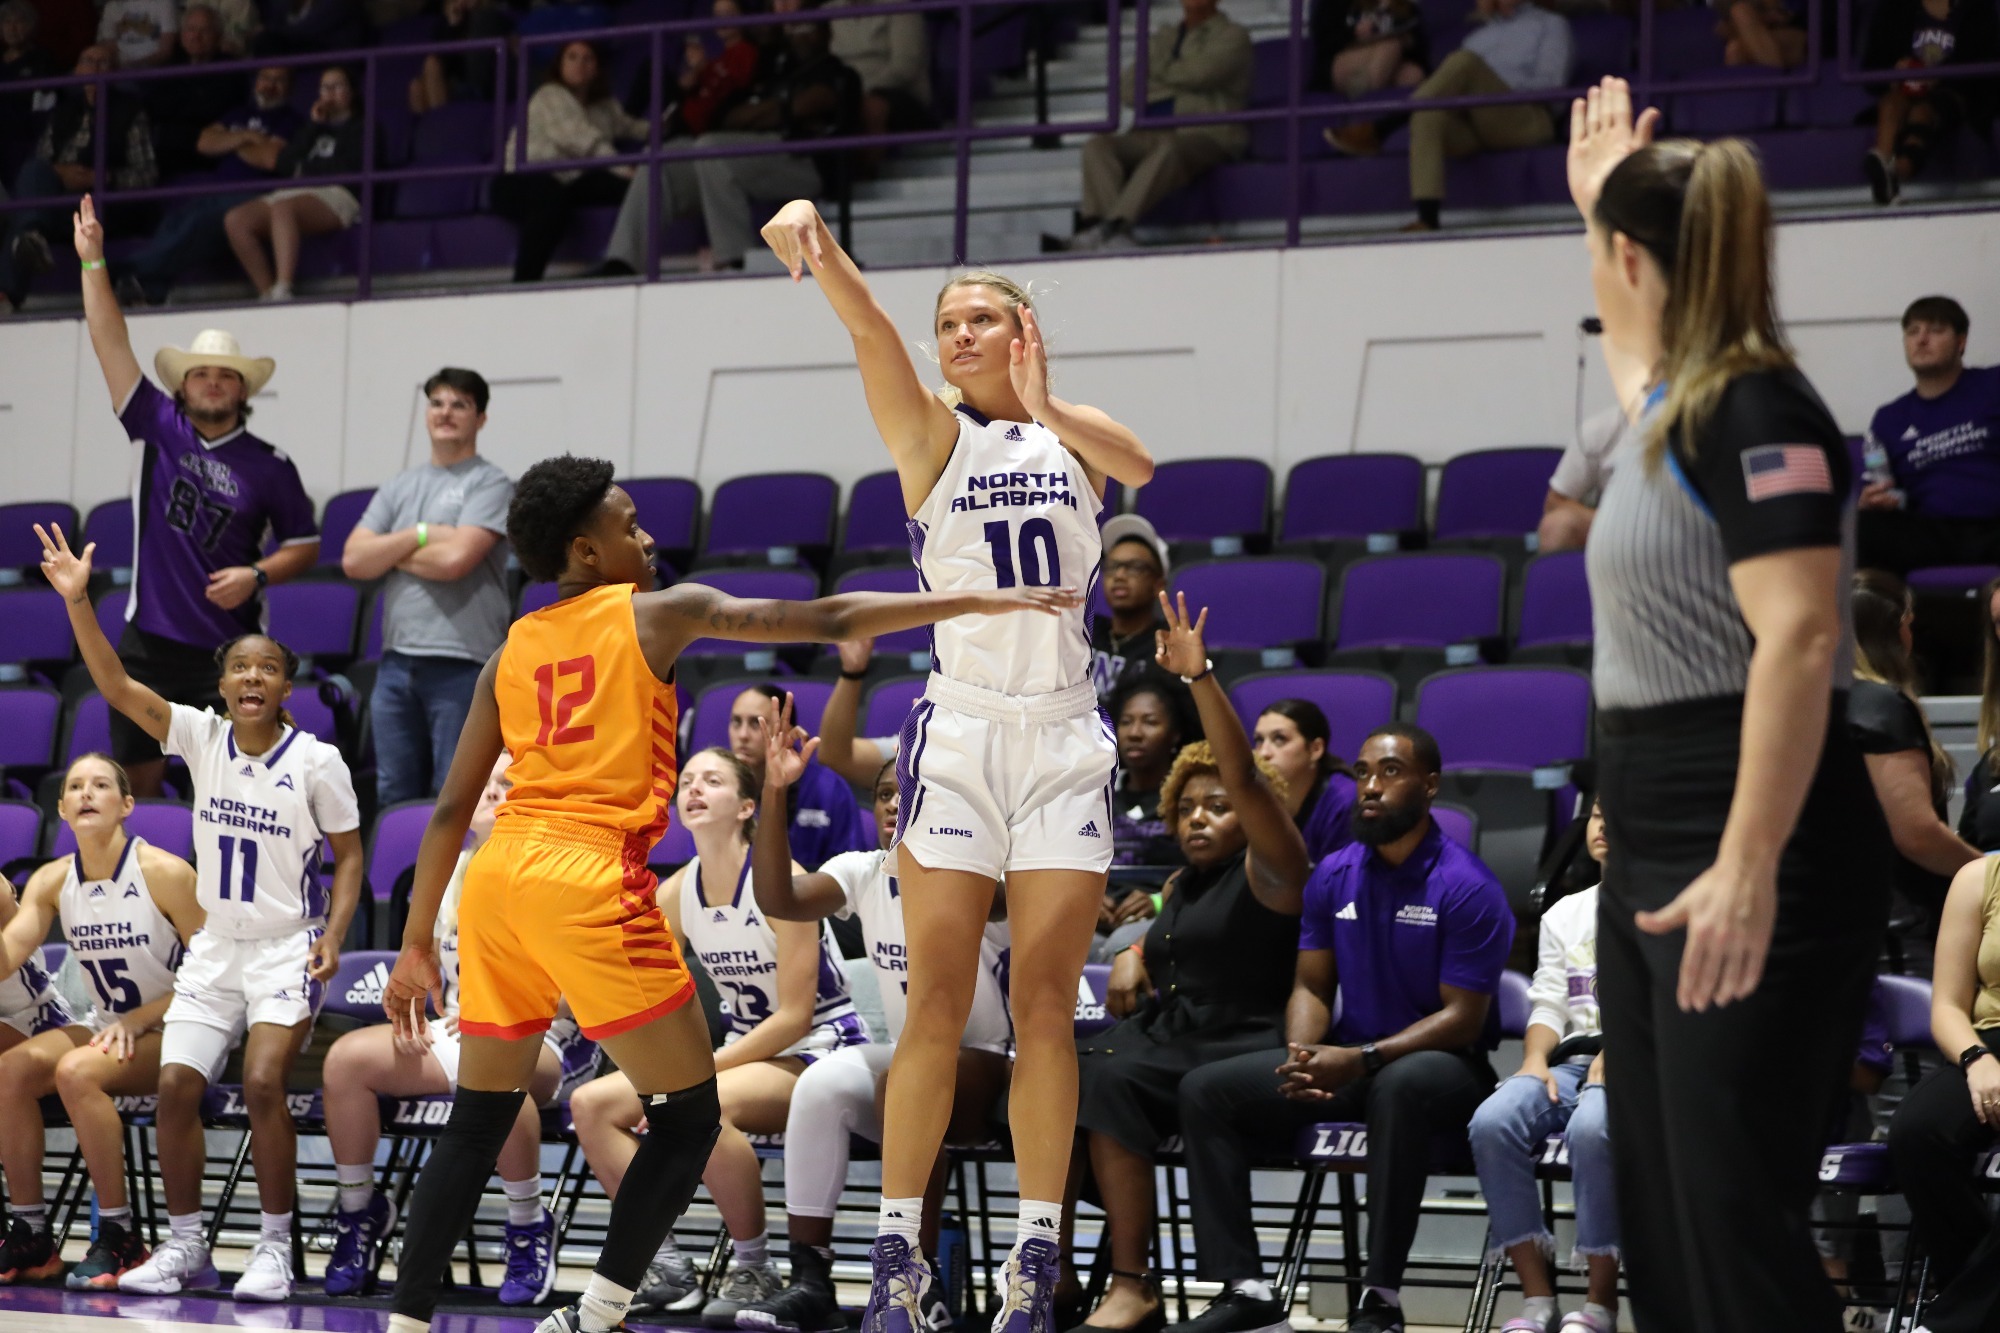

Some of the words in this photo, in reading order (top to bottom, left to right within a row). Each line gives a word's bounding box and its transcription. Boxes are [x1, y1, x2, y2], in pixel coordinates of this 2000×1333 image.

[968, 472, 1069, 491] NORTH
[165, 476, 235, 551] 87
[984, 517, 1061, 589] 10
[534, 654, 596, 747] 12
[210, 797, 278, 821] NORTH
[200, 810, 291, 838] ALABAMA
[929, 827, 973, 838] LIONS
[1078, 830, 1100, 839] adidas
[219, 835, 258, 902] 11
[70, 922, 132, 938] NORTH
[701, 950, 759, 964] NORTH
[706, 962, 777, 977] ABAMA
[80, 958, 142, 1014] 15
[345, 984, 384, 1005] adid
[1074, 1001, 1106, 1020] das
[394, 1101, 454, 1125] LIO
[1310, 1130, 1367, 1157] LIO
